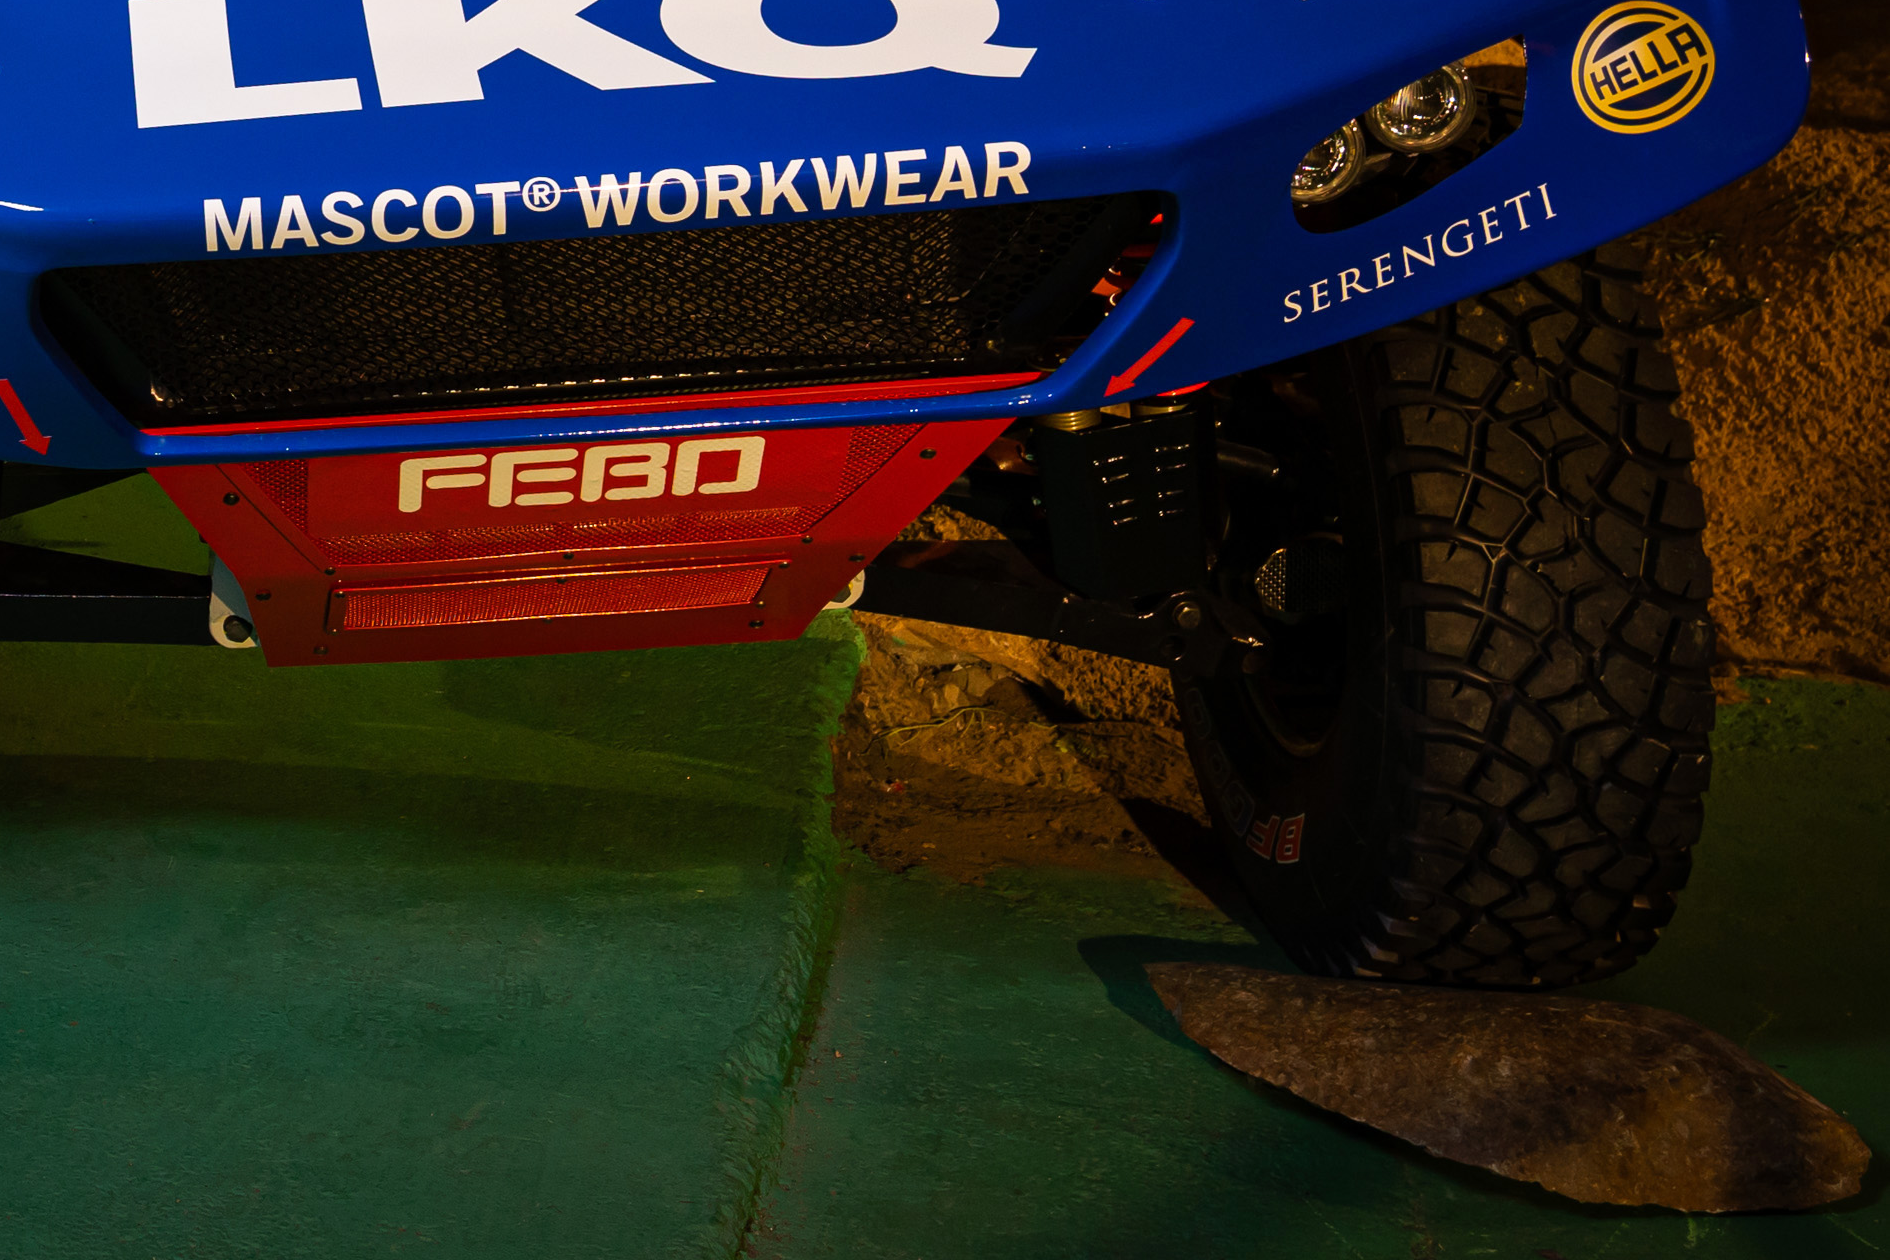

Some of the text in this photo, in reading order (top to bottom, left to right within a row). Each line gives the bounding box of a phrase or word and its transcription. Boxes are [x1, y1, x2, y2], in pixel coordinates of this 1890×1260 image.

[1590, 22, 1707, 101] HELLA
[574, 139, 1033, 228] WORKWEAR
[1282, 182, 1558, 324] SERENGETI
